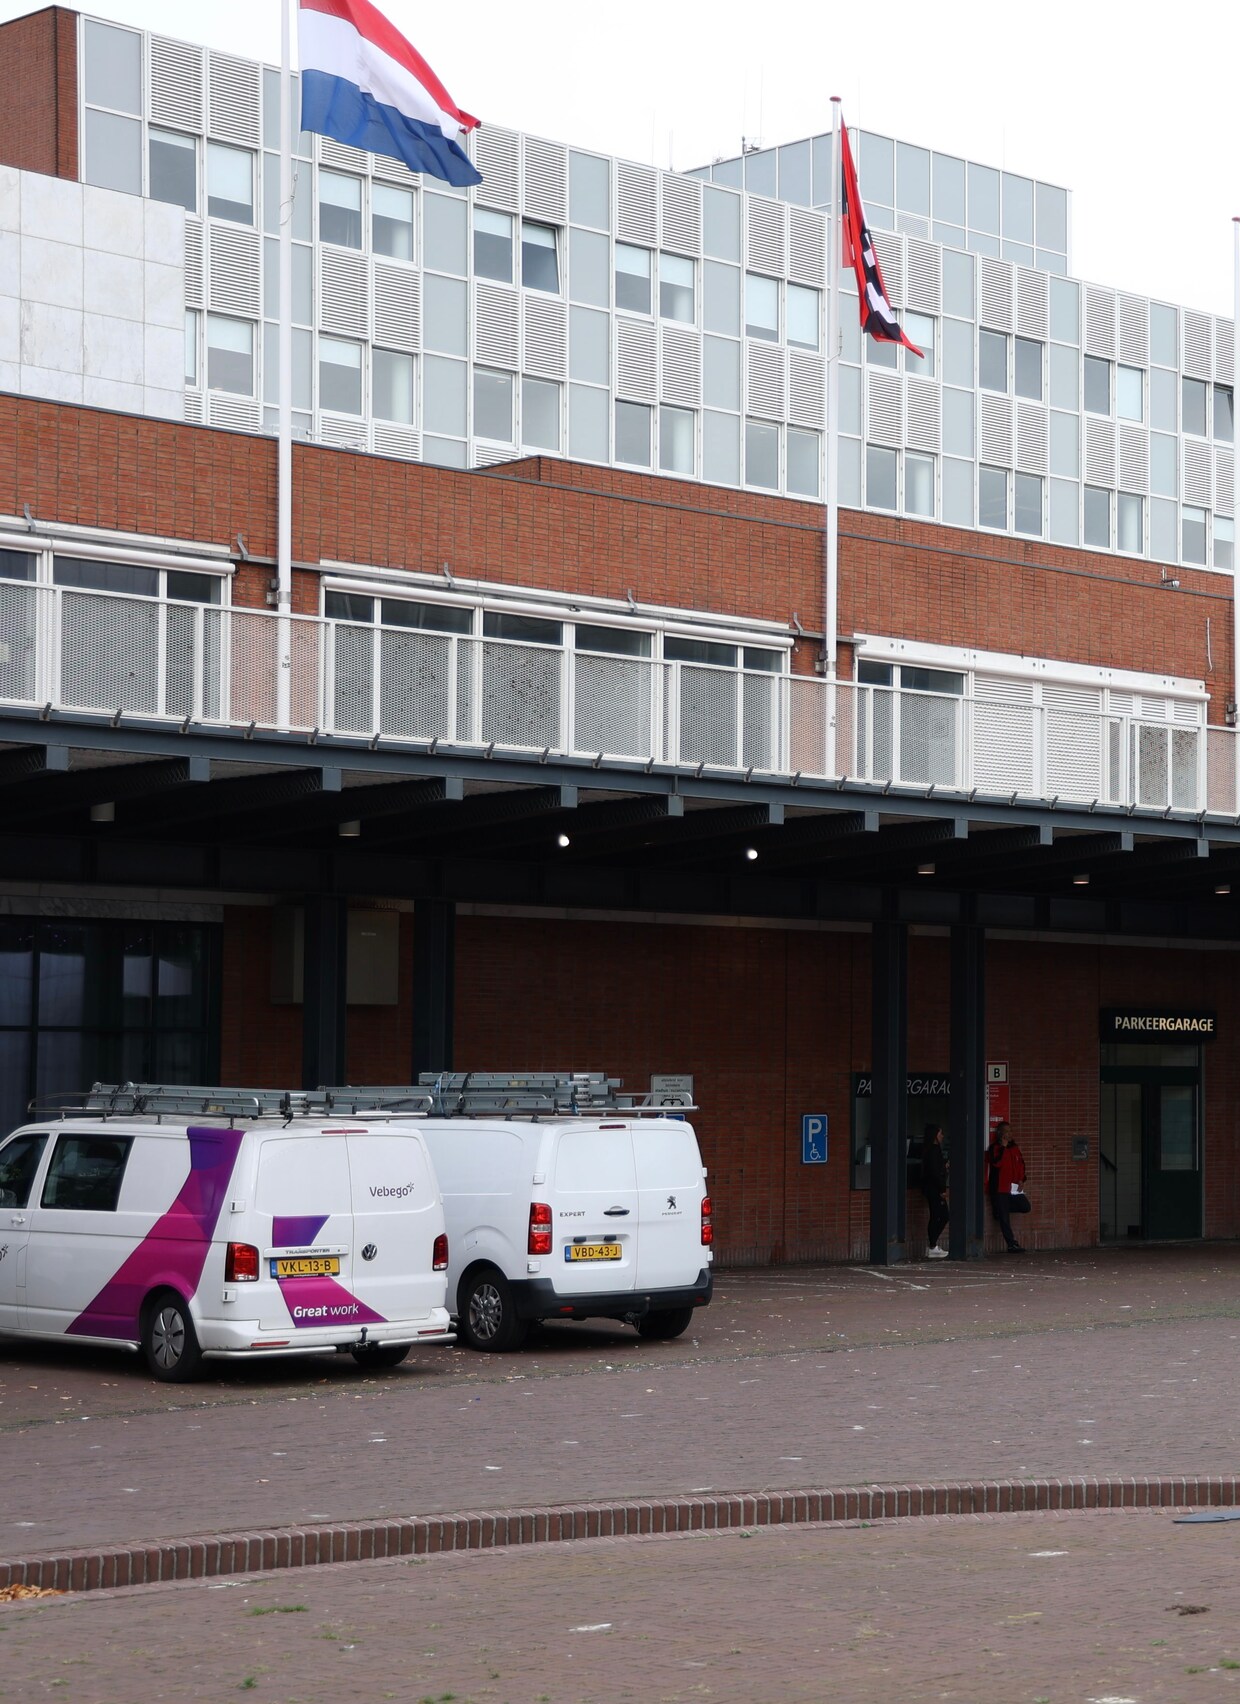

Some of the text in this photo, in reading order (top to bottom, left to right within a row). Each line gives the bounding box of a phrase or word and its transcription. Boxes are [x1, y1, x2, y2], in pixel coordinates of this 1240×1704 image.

[1115, 1016, 1214, 1032] PARKEERGARAGE
[994, 1068, 1000, 1078] B
[808, 1118, 822, 1143] P
[369, 1186, 409, 1199] Vebego
[574, 1246, 618, 1257] VBD-43-J
[281, 1260, 331, 1272] VKL-13-B
[293, 1303, 359, 1318] Great work
